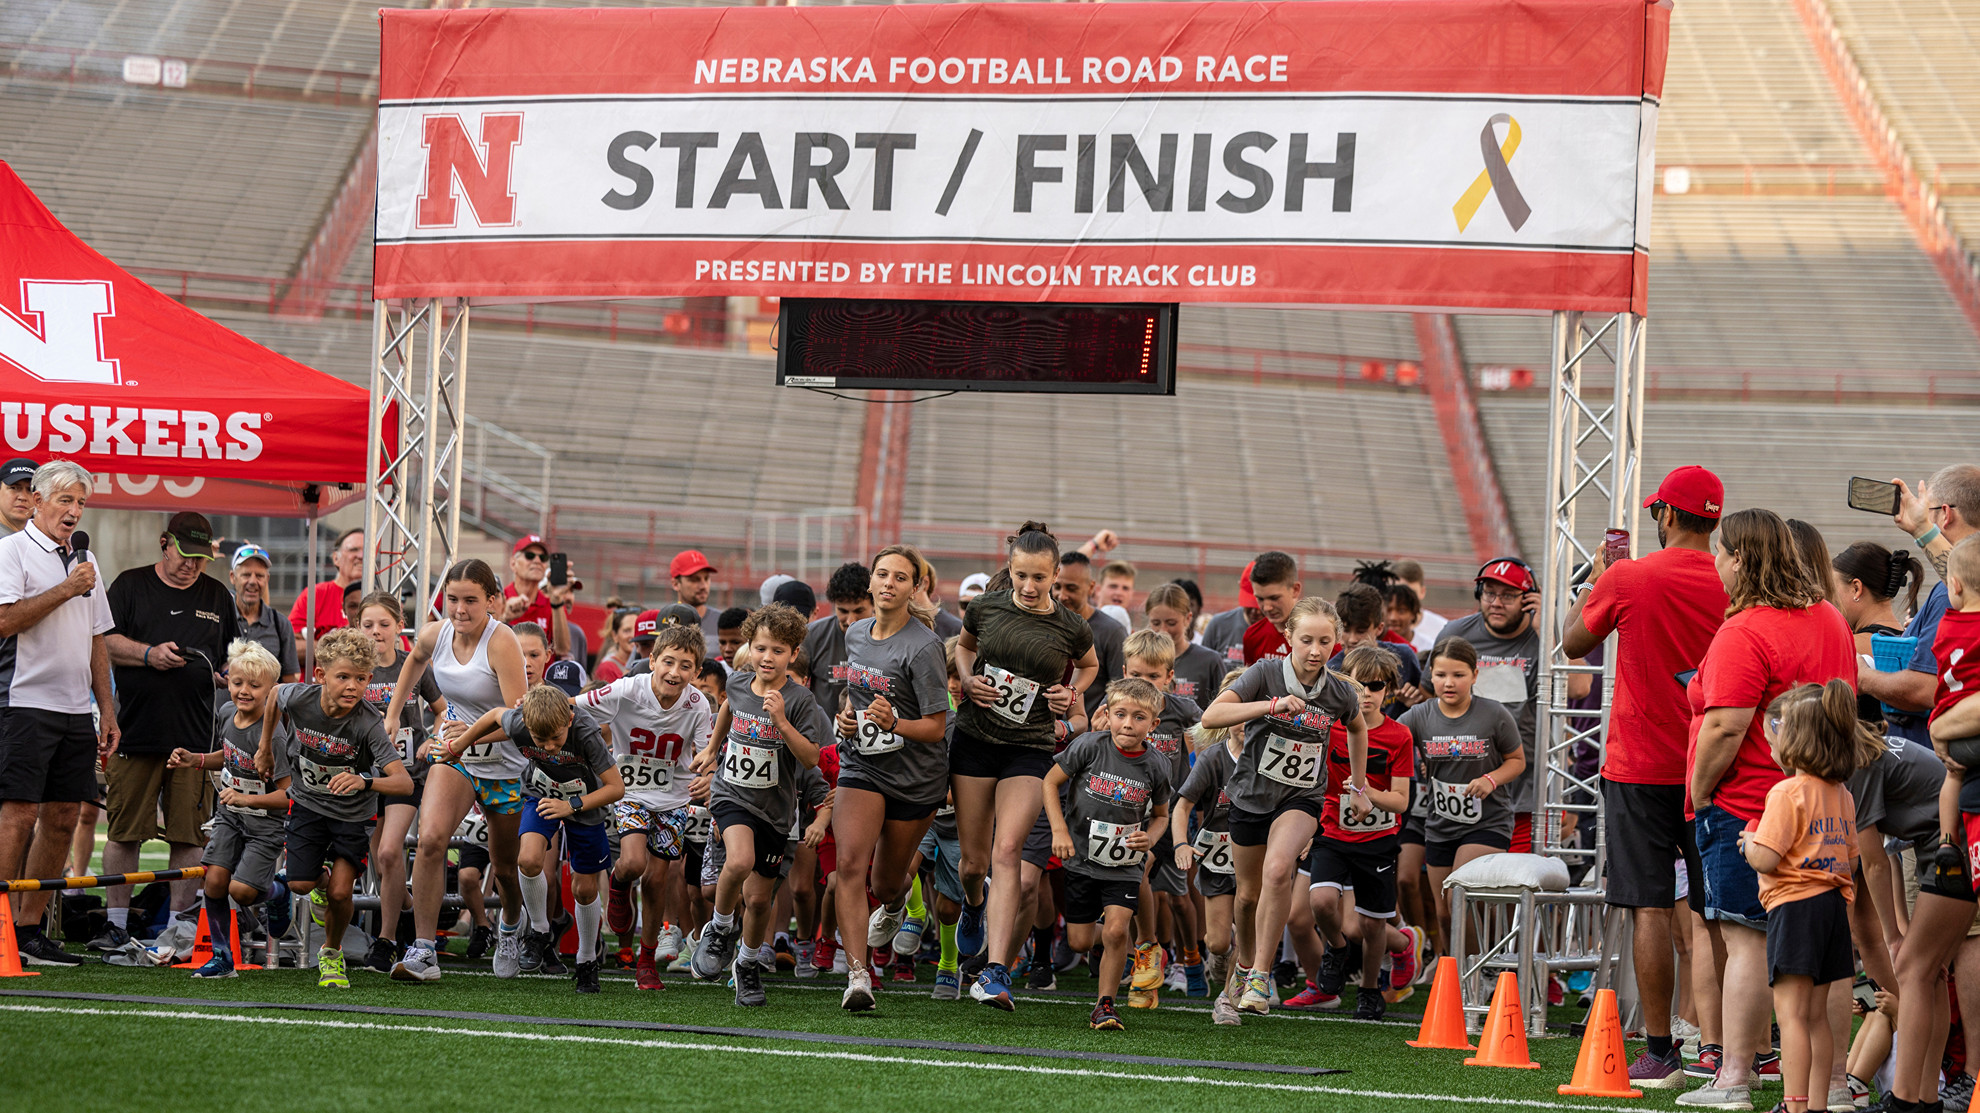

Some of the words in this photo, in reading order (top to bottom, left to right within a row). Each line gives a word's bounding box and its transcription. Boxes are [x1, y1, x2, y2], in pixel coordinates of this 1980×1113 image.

[693, 56, 877, 85] NEBRASKA
[888, 56, 1072, 85] FOOTBALL
[1081, 56, 1184, 84] ROAD
[1194, 54, 1289, 83] RACE
[415, 111, 525, 230] N
[600, 129, 917, 212] START
[934, 128, 984, 217] /
[1012, 130, 1357, 214] FINISH
[694, 259, 857, 284] PRESENTED
[860, 261, 896, 283] BY
[901, 261, 952, 285] THE
[961, 263, 1083, 287] LINCOLN
[1089, 264, 1181, 287] TRACK
[1187, 264, 1257, 287] CLUB
[0, 278, 122, 386] N
[1, 401, 264, 462] USKERS
[10, 466, 36, 474] SAUCON
[1494, 562, 1511, 576] N
[538, 618, 548, 629] N
[869, 674, 891, 693] RACE
[1004, 673, 1015, 685] N
[1173, 683, 1196, 696] ACE
[1304, 711, 1331, 731] RACE
[329, 741, 357, 757] RACE
[467, 742, 494, 757] 17
[629, 727, 685, 762] 20
[742, 746, 751, 756] N
[1155, 739, 1178, 753] RACE
[1291, 742, 1303, 753] N
[1425, 741, 1450, 755] ROAD
[1461, 740, 1486, 754] RACE
[640, 757, 650, 765] N
[725, 753, 772, 782] 494
[1263, 746, 1317, 782] 782
[302, 767, 333, 786] 34
[318, 765, 328, 773] N
[232, 777, 241, 787] N
[551, 781, 560, 789] N
[1100, 771, 1123, 782] NEBRASKA
[1124, 777, 1145, 789] FOOTBALL
[1090, 775, 1116, 797] ROAD
[1124, 785, 1150, 803] RACE
[1448, 785, 1457, 794] N
[1115, 826, 1124, 836] N
[1219, 833, 1228, 843] N
[1197, 840, 1235, 868] 76
